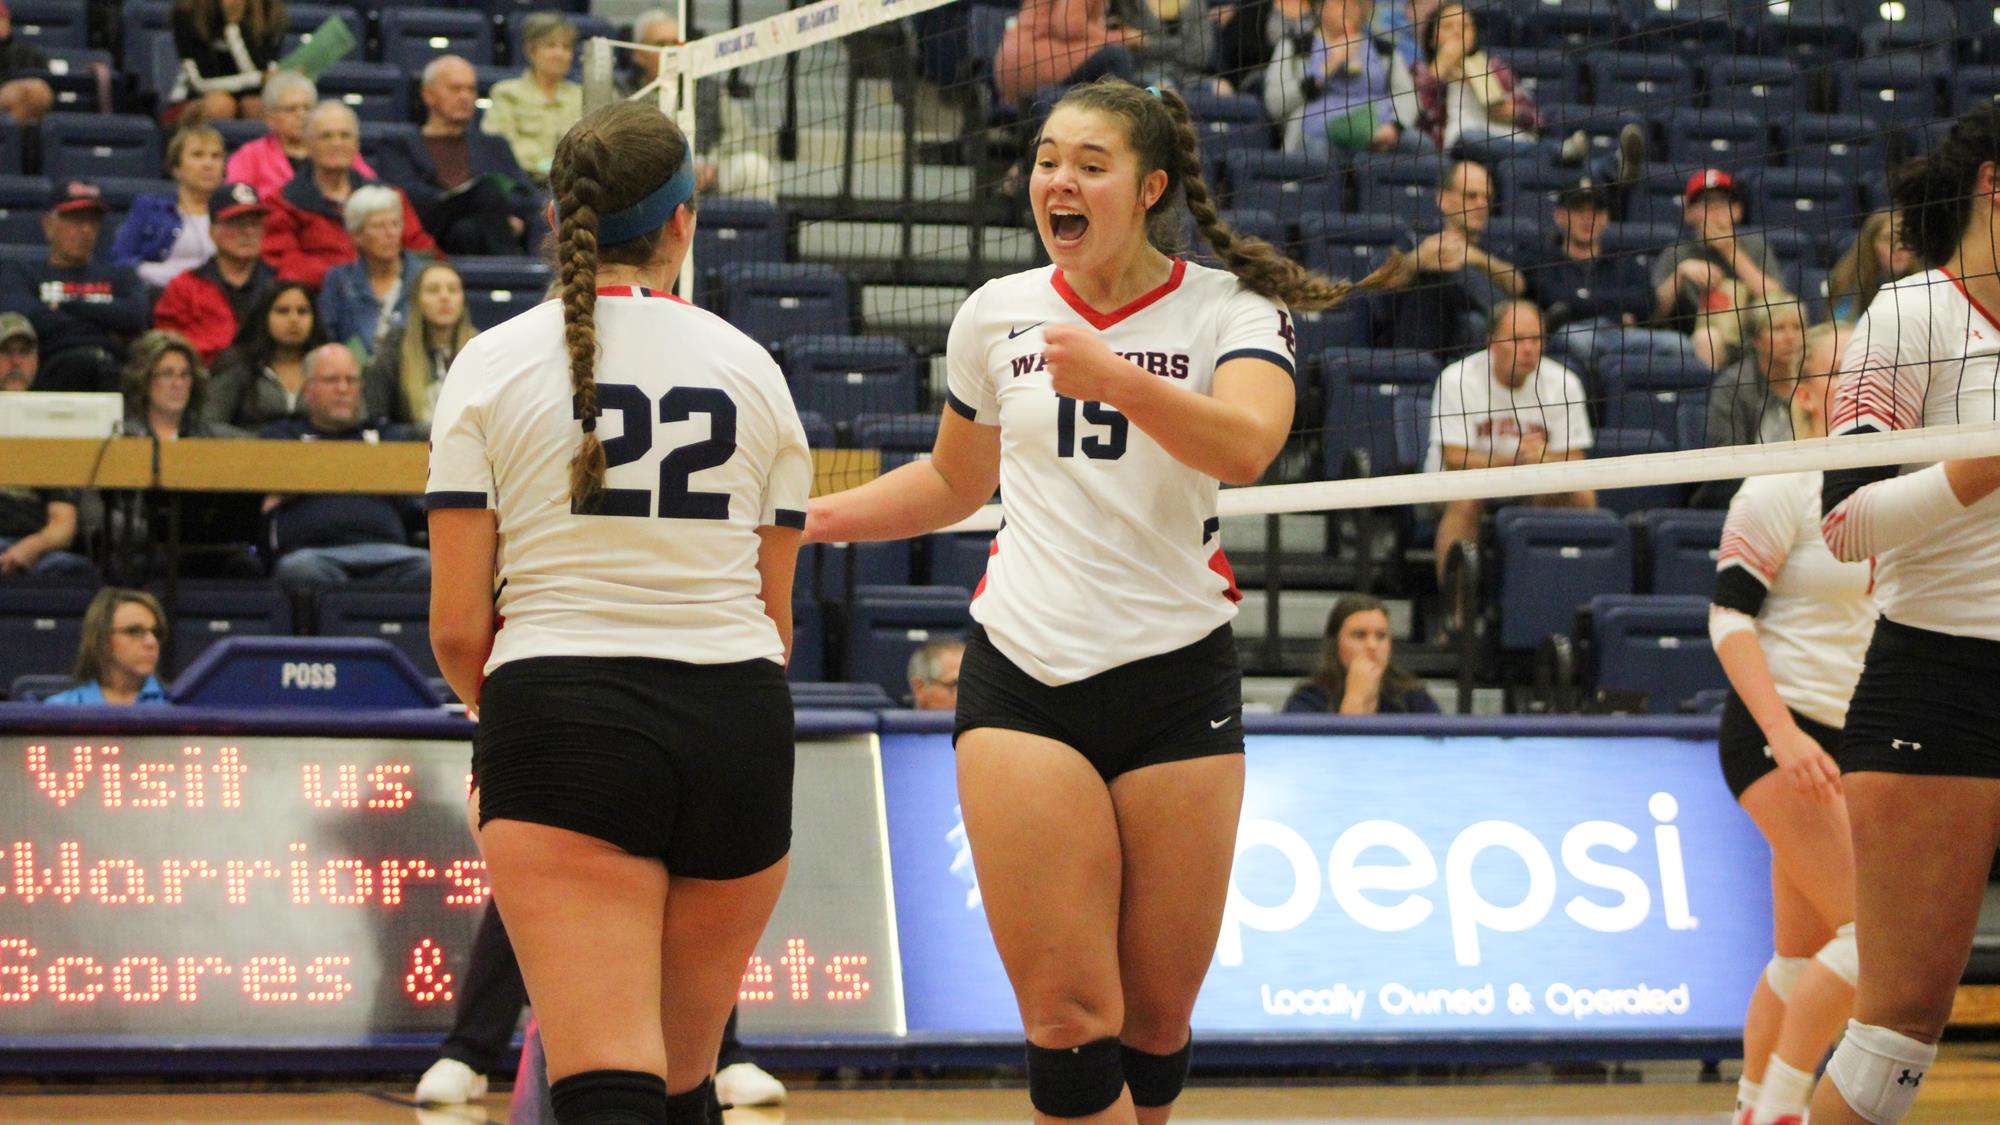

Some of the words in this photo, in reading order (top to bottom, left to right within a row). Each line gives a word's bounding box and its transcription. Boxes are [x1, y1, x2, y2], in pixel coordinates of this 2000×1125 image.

[1011, 351, 1189, 379] WAORS
[571, 383, 738, 520] 22
[1055, 392, 1129, 461] 15
[281, 662, 337, 689] POSS
[27, 746, 247, 808] Visit
[302, 764, 413, 808] us
[0, 841, 490, 905] Warriors
[1214, 791, 1692, 968] pepsi
[0, 938, 353, 1001] Scores
[405, 939, 454, 1001] &
[1260, 983, 1366, 1022] Locally
[1378, 982, 1495, 1016] Owned
[1507, 983, 1536, 1016] &
[1544, 982, 1691, 1021] Operated
